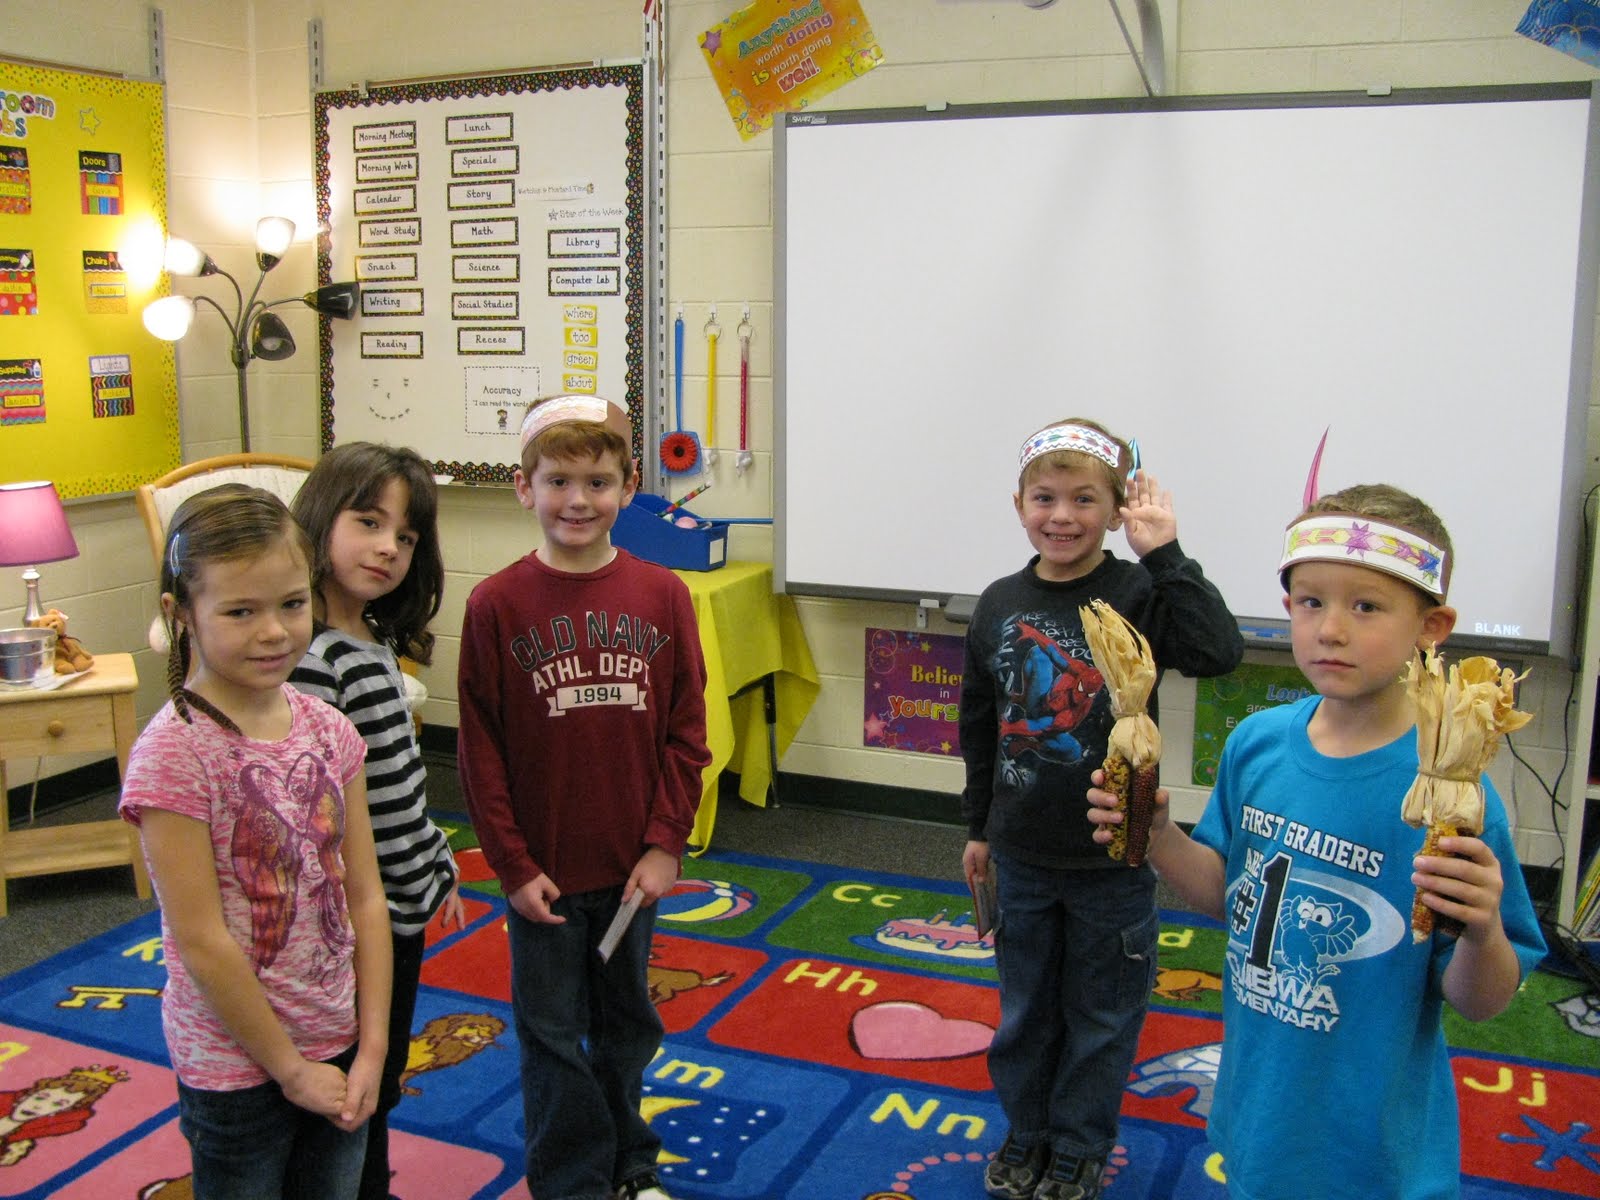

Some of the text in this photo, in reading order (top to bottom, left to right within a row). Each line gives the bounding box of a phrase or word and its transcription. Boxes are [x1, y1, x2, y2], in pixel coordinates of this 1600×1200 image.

[738, 0, 824, 58] Anything
[755, 12, 833, 66] worth doing
[751, 35, 832, 86] is worth doing
[464, 122, 491, 132] Lunch
[359, 130, 414, 142] Morning Meeting
[82, 156, 106, 167] Doors
[361, 161, 413, 173] Morning Work
[462, 155, 497, 168] Specials
[366, 194, 401, 204] Calendar
[466, 190, 492, 200] Story
[369, 225, 416, 237] Word Study
[471, 226, 494, 235] Math
[566, 237, 600, 248] Library
[85, 256, 108, 265] Chairs
[367, 262, 397, 271] Snack
[468, 263, 500, 271] Science
[555, 274, 610, 287] Computer Lab
[369, 296, 400, 307] Writing
[457, 300, 513, 309] Social Studies
[565, 307, 593, 318] where
[475, 334, 507, 344] Recess
[573, 332, 590, 343] too
[376, 339, 407, 350] Reading
[566, 354, 594, 366] green
[565, 376, 593, 389] about
[483, 385, 522, 396] Accuracy
[1475, 622, 1521, 636] BLANK
[511, 611, 671, 673] OLD NAVY
[532, 655, 593, 695] ATHL.
[574, 686, 622, 704] 1994
[940, 688, 950, 699] in
[1241, 805, 1385, 878] FIRST GRADERS
[832, 884, 902, 908] Cc
[784, 961, 879, 997] Hh
[1462, 1067, 1548, 1107] Jj
[869, 1093, 986, 1139] Nn
